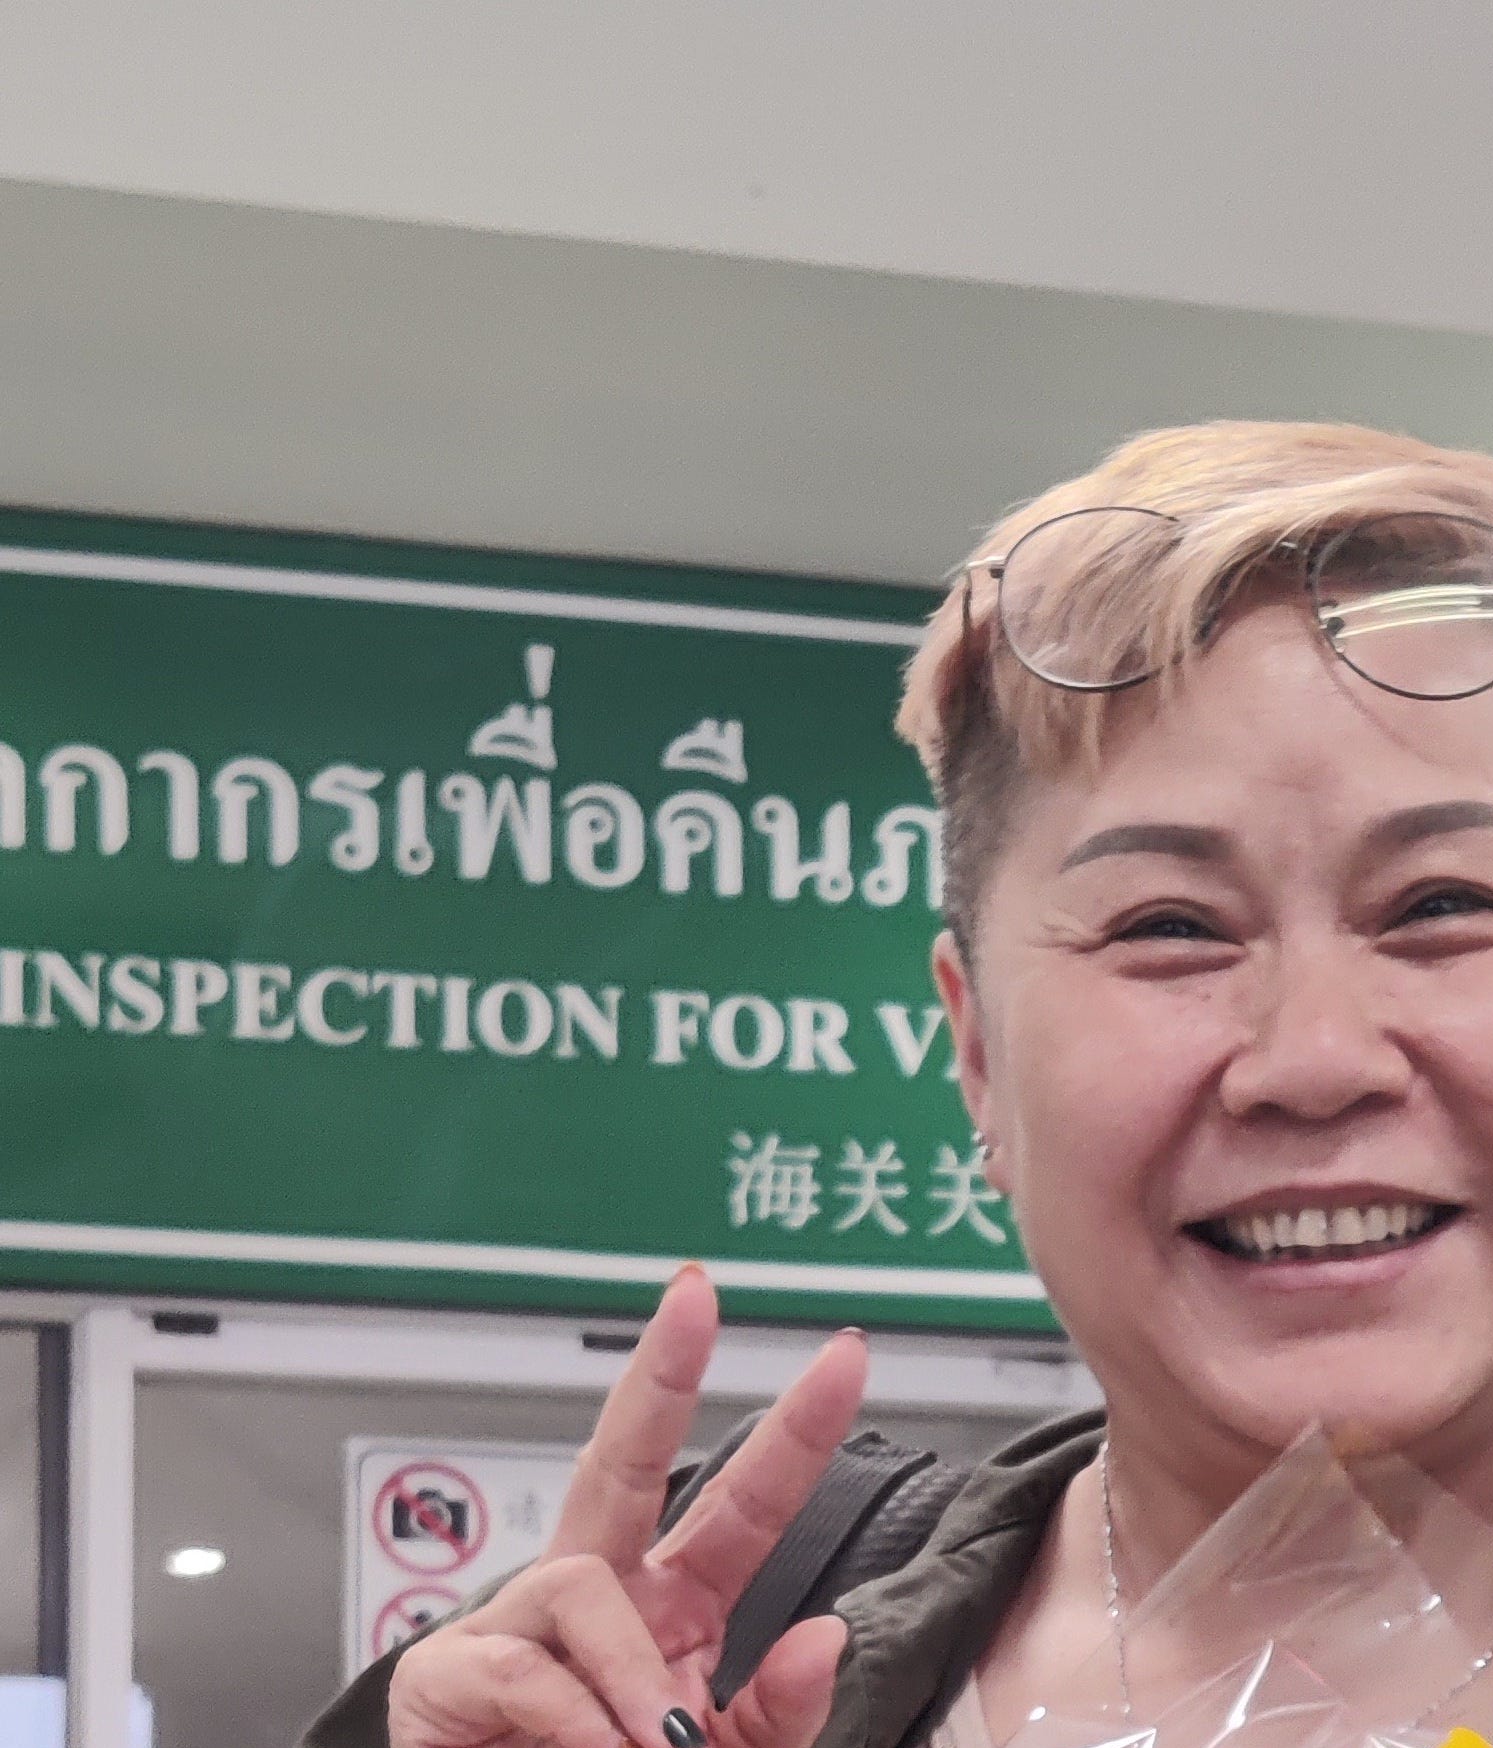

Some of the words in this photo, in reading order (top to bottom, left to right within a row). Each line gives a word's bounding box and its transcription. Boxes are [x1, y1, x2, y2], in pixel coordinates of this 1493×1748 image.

[0, 948, 623, 1061] INSPECTION
[650, 990, 857, 1075] FOR
[875, 1004, 961, 1083] V
